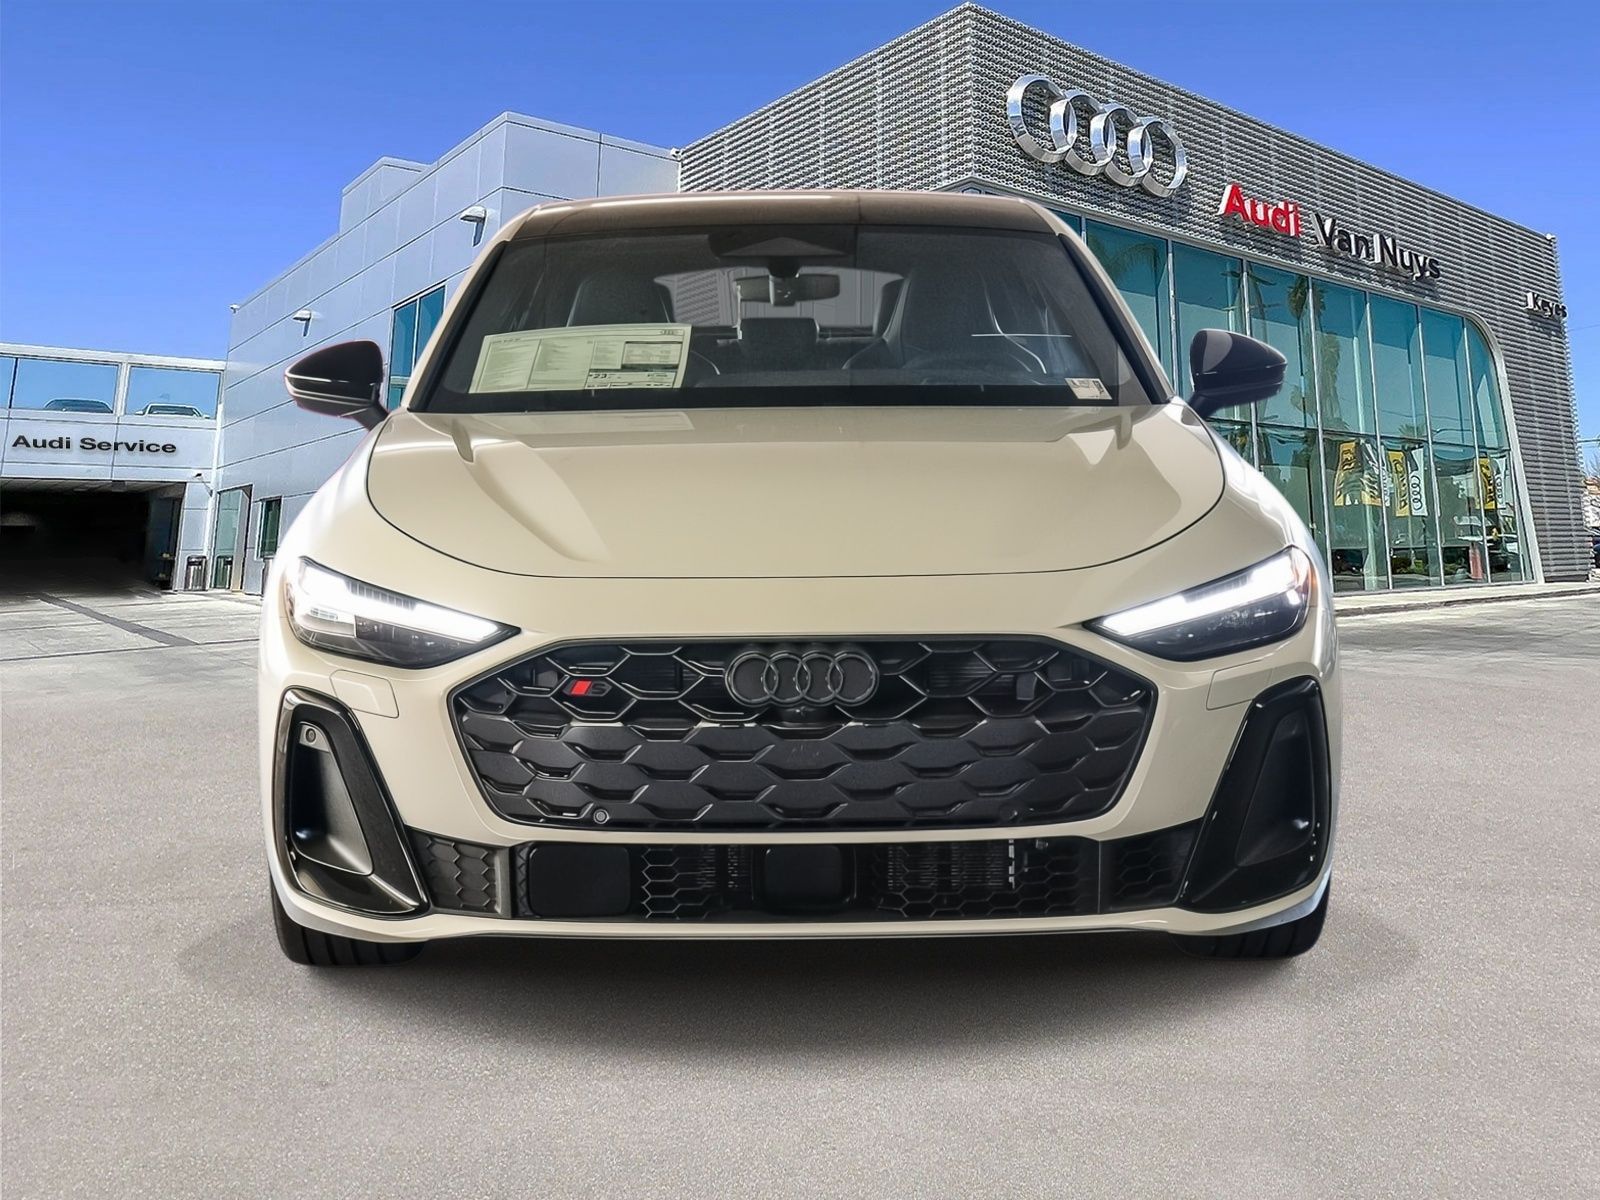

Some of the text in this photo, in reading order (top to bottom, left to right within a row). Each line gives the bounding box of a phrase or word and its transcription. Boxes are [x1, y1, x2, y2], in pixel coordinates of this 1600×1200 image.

[1218, 182, 1441, 281] Audi Van Nuys
[12, 434, 177, 454] Audi Service
